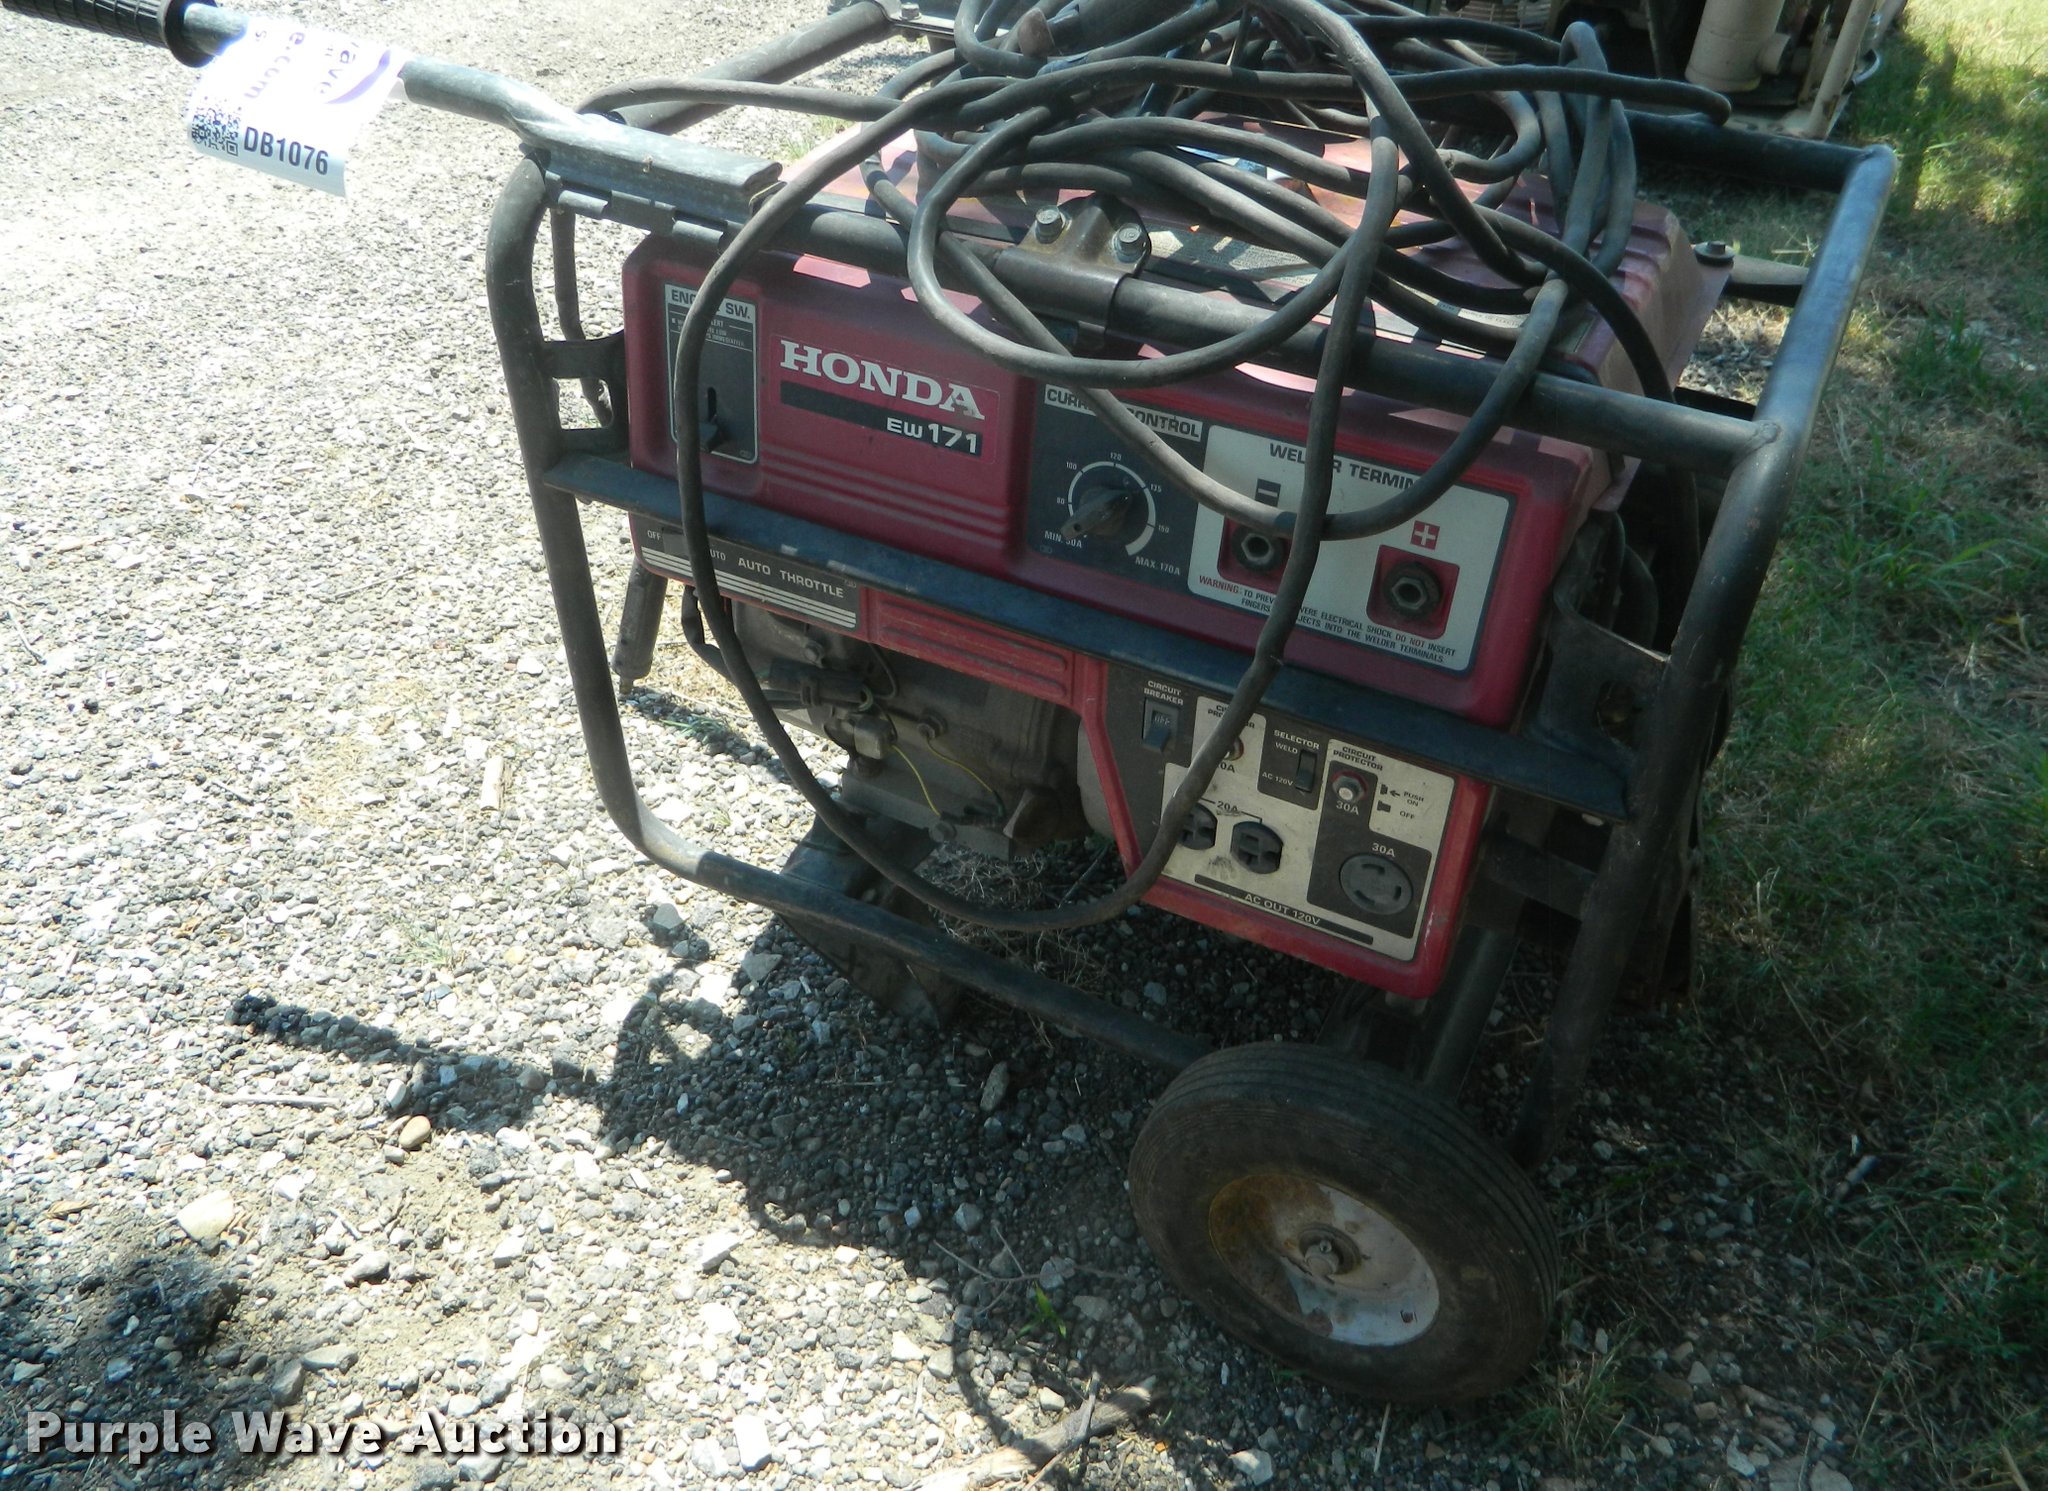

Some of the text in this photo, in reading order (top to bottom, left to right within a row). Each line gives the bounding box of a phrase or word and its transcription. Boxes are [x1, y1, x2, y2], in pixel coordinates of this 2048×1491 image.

[243, 126, 329, 176] DB1076
[725, 302, 750, 319] SW.
[780, 340, 985, 420] HONDA
[1110, 452, 1122, 461] 120
[1066, 462, 1078, 470] 100
[1269, 443, 1415, 490] WELR TERMIN
[647, 530, 662, 541] OFF
[709, 549, 726, 561] UTO
[1160, 562, 1181, 576] 170A
[738, 557, 845, 599] AUTO THROTTLE
[1241, 598, 1444, 662] FINGERS JECTS INTO THE WELDER TERMINALS
[1243, 589, 1253, 599] TO
[1256, 592, 1275, 604] PREV
[1300, 606, 1318, 617] VERE
[1321, 612, 1363, 630] ELECTRICAL
[1367, 625, 1391, 638] SHOCK
[1395, 634, 1407, 643] DO
[1410, 638, 1425, 648] NOT
[1428, 643, 1455, 656] INSERT
[1147, 680, 1182, 696] CIRCUIT
[1143, 688, 1184, 706] BREAKER
[1273, 729, 1320, 750] SELECTOR
[1275, 742, 1298, 755] WELD
[1342, 746, 1377, 762] CIRCUIT
[1218, 762, 1235, 773] 0A
[1333, 750, 1384, 772] PROTECTOR
[1262, 771, 1293, 787] AC 120V
[1403, 791, 1424, 802] PUSH
[1407, 799, 1419, 807] ON
[1217, 801, 1239, 813] 20A
[1336, 801, 1360, 815] 30A
[1399, 811, 1416, 820] OFF
[1371, 842, 1396, 858] 30A
[1244, 893, 1321, 925] AC OUT 120V
